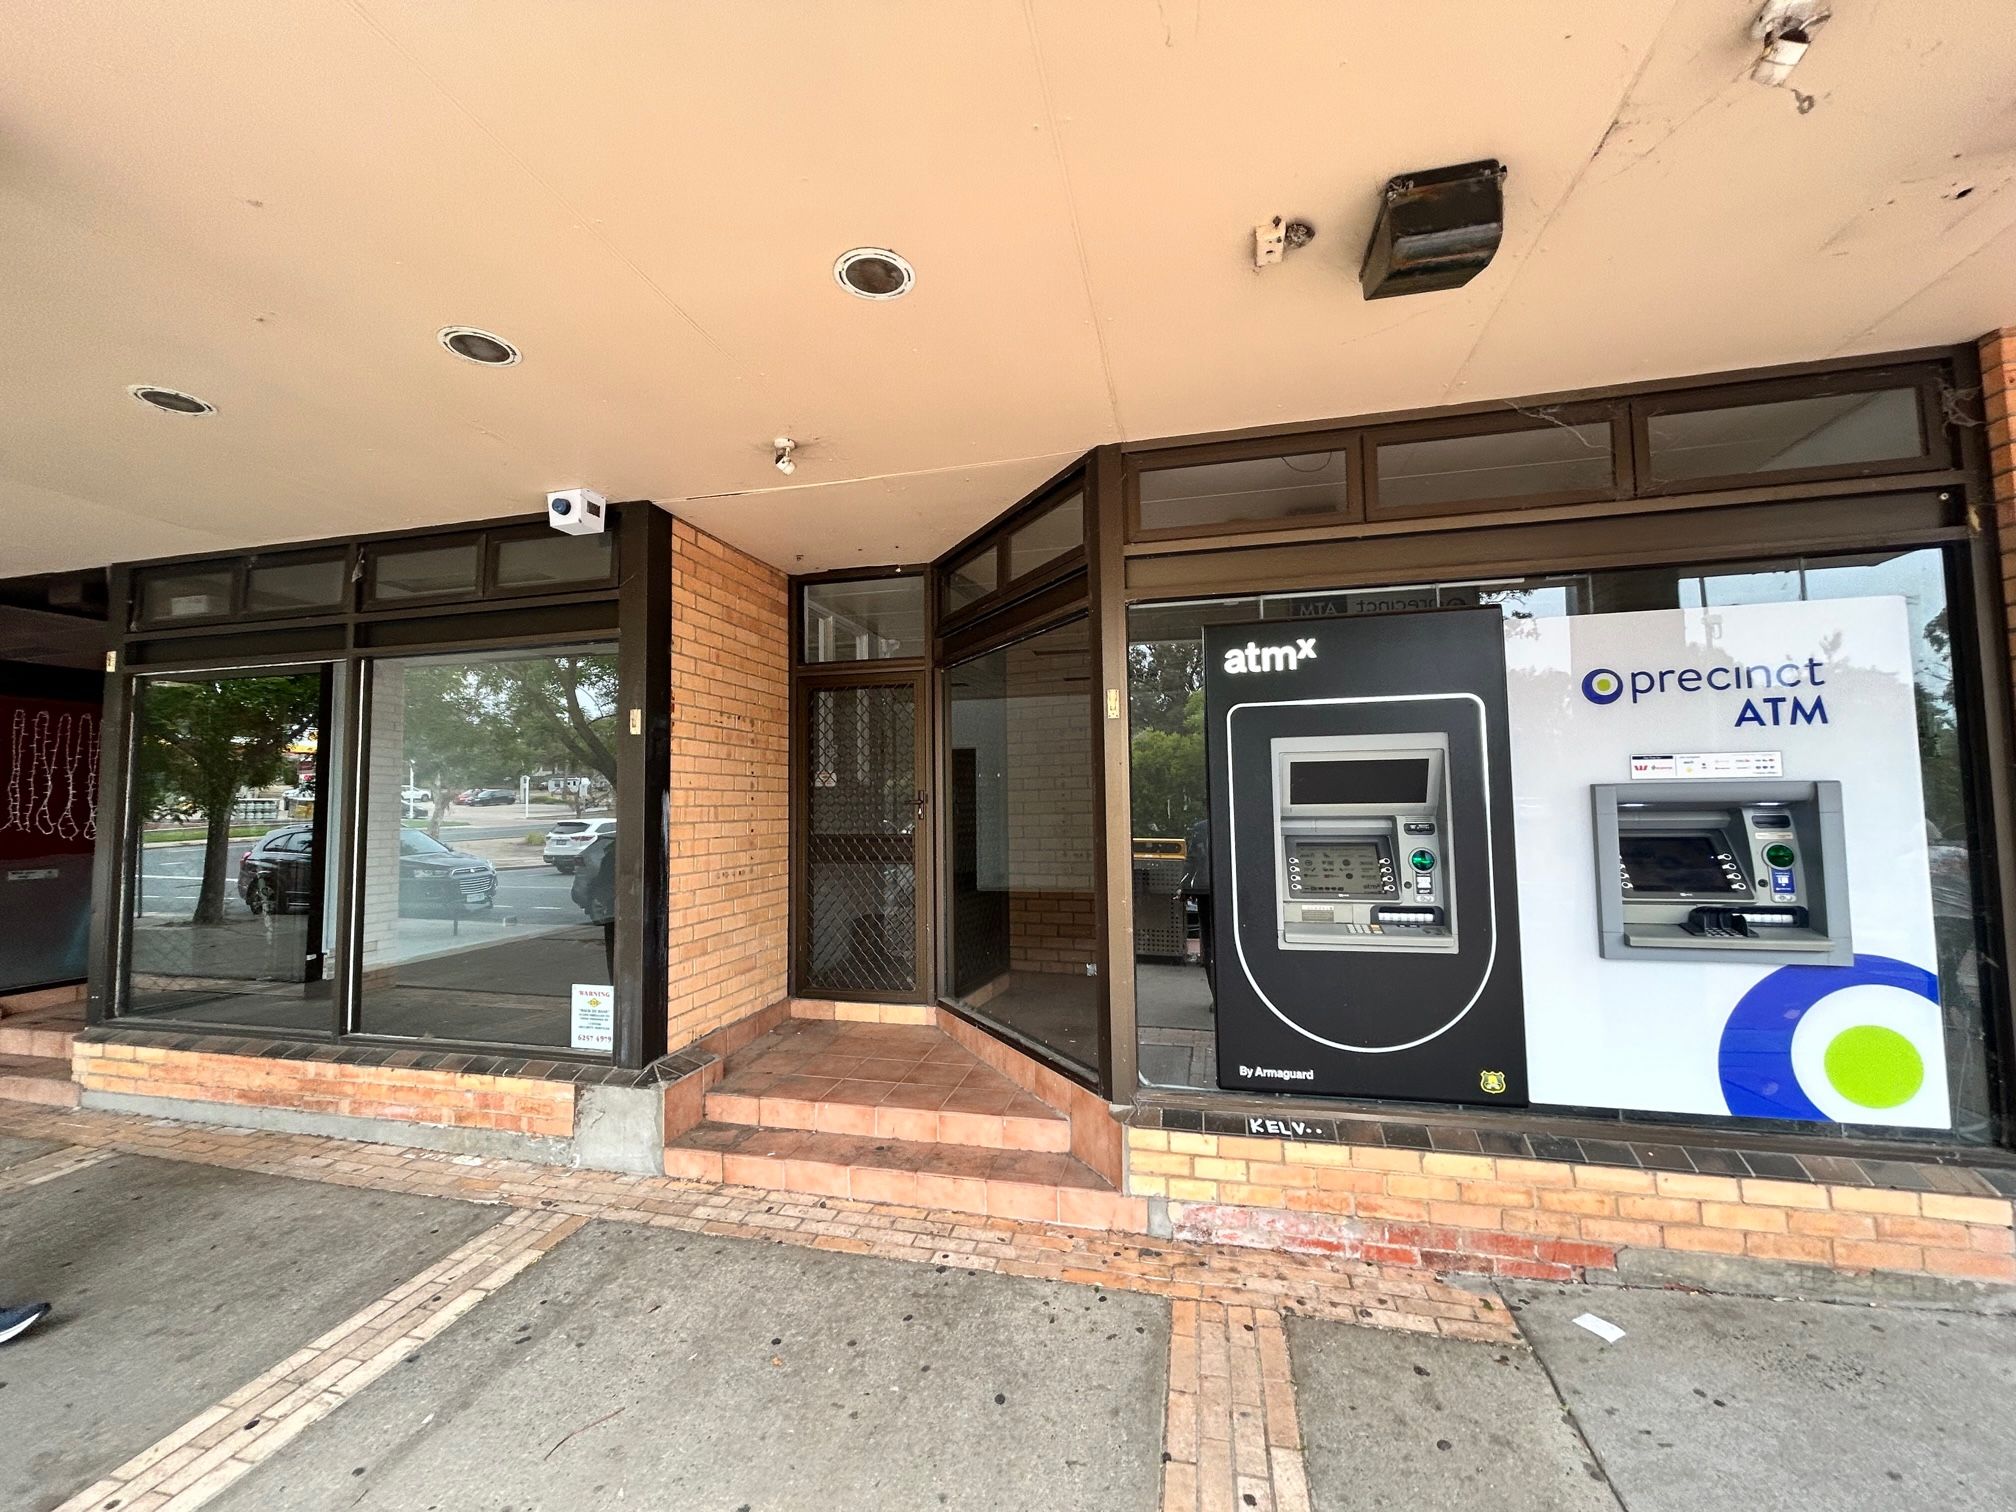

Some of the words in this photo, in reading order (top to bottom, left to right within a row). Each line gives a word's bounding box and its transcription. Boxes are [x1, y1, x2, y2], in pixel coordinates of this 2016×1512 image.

[1630, 657, 1826, 704] precinct
[1734, 695, 1829, 728] ATM
[578, 990, 610, 998] WARNING
[1239, 1066, 1253, 1079] By
[1254, 1066, 1315, 1081] Armaguard
